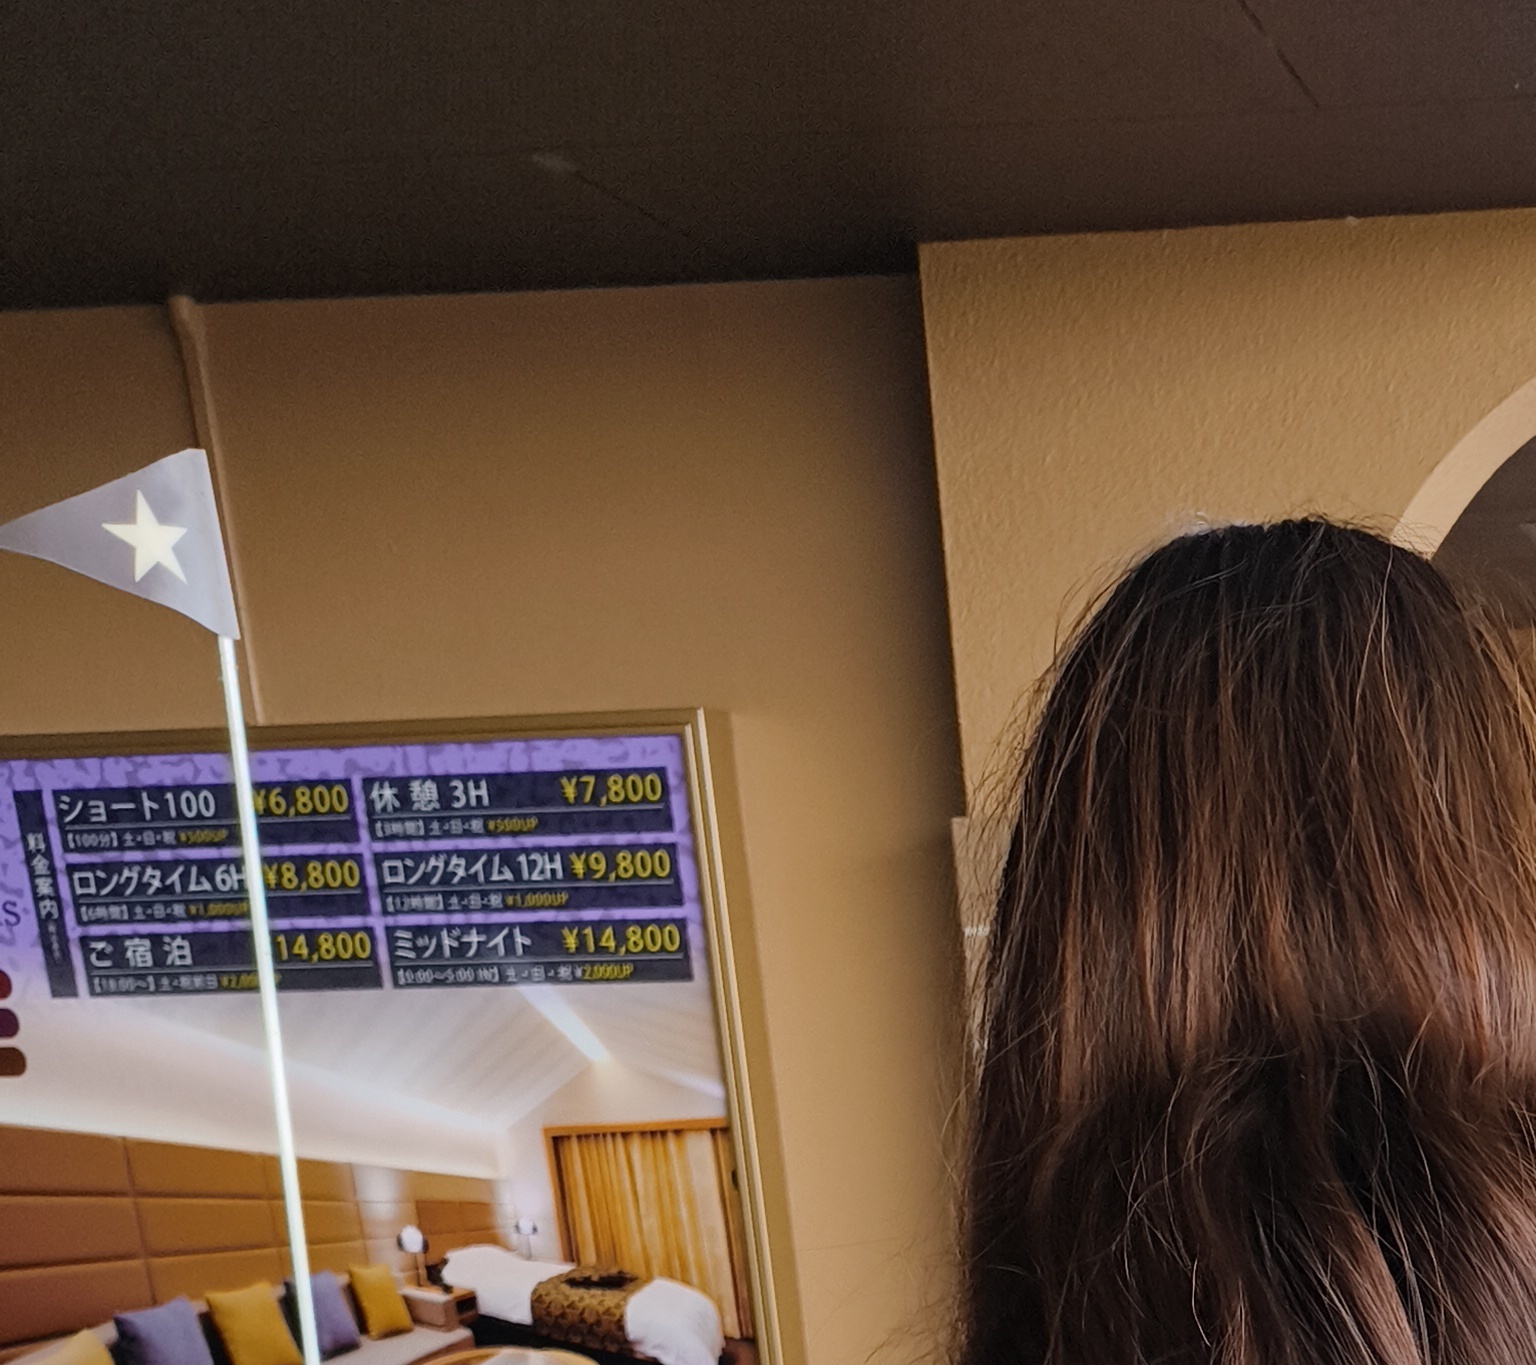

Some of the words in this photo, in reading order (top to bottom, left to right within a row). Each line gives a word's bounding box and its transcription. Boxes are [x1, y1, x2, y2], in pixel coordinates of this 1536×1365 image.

[561, 773, 662, 807] ¥7,800
[264, 859, 360, 892] ¥8,800
[568, 849, 671, 882] ¥9,800
[89, 935, 194, 968] ご宿泊
[394, 926, 532, 959] ミッドナイト
[561, 923, 681, 956] ¥14,800
